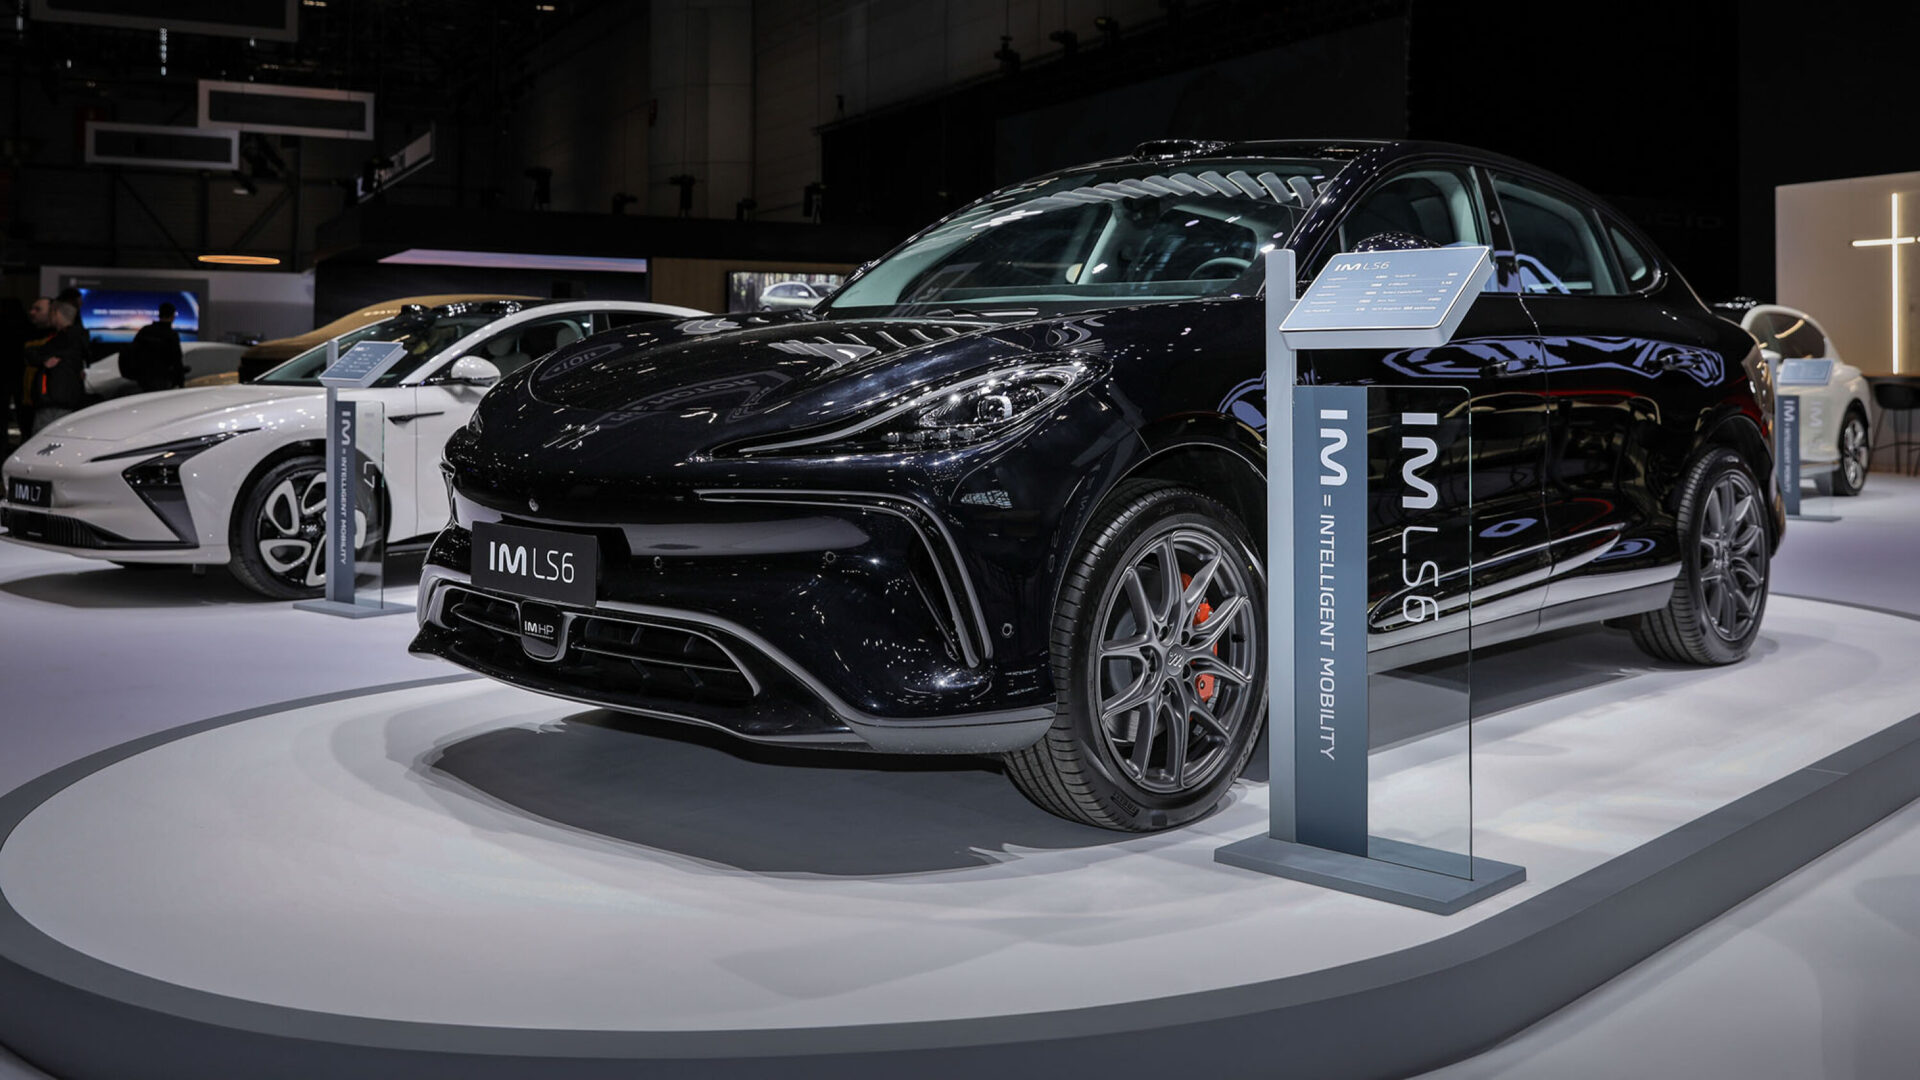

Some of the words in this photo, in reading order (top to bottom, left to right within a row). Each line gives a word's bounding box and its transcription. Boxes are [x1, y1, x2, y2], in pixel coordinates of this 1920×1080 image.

[1334, 263, 1361, 271] IM
[1363, 261, 1390, 270] LS6
[341, 411, 352, 446] IM
[1784, 400, 1795, 422] IM
[1320, 409, 1348, 486] IM
[1401, 412, 1438, 510] IM
[15, 483, 29, 501] IM
[489, 541, 527, 576] IM
[533, 547, 575, 584] LS6
[1320, 514, 1335, 651] INTELLIGENT
[1402, 526, 1439, 623] LS6
[524, 620, 538, 634] IM
[538, 624, 554, 636] HP
[1320, 658, 1335, 761] MOBILITY
